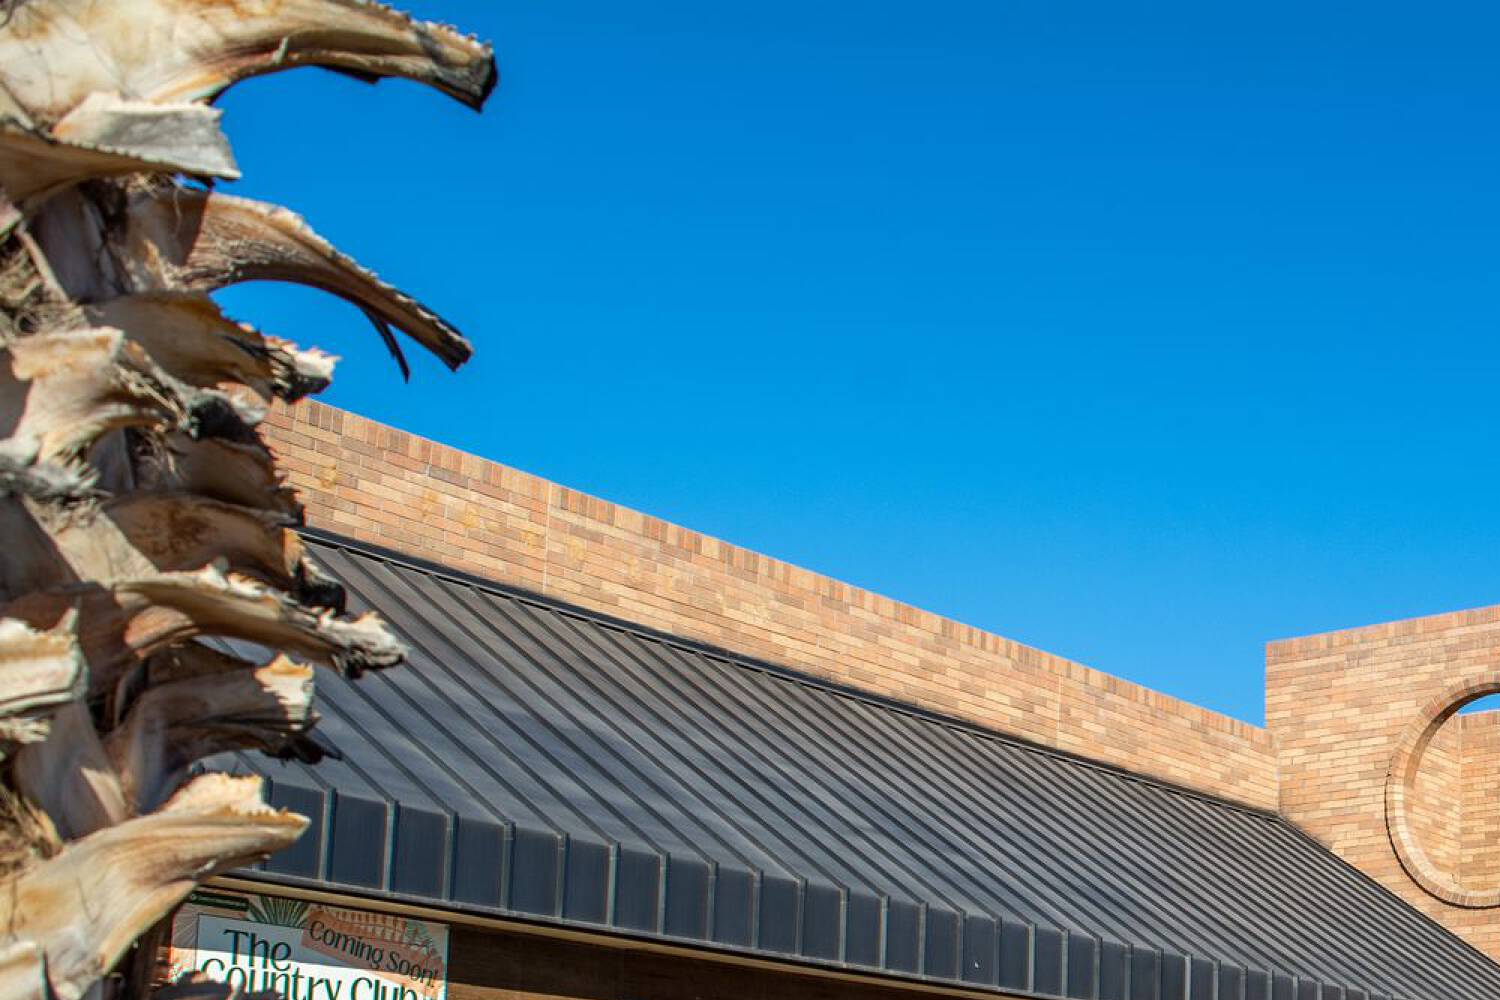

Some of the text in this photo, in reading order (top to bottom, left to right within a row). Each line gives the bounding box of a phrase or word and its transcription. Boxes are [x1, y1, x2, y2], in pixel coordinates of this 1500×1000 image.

[223, 928, 291, 972] The
[309, 920, 439, 988] Coming Soon!
